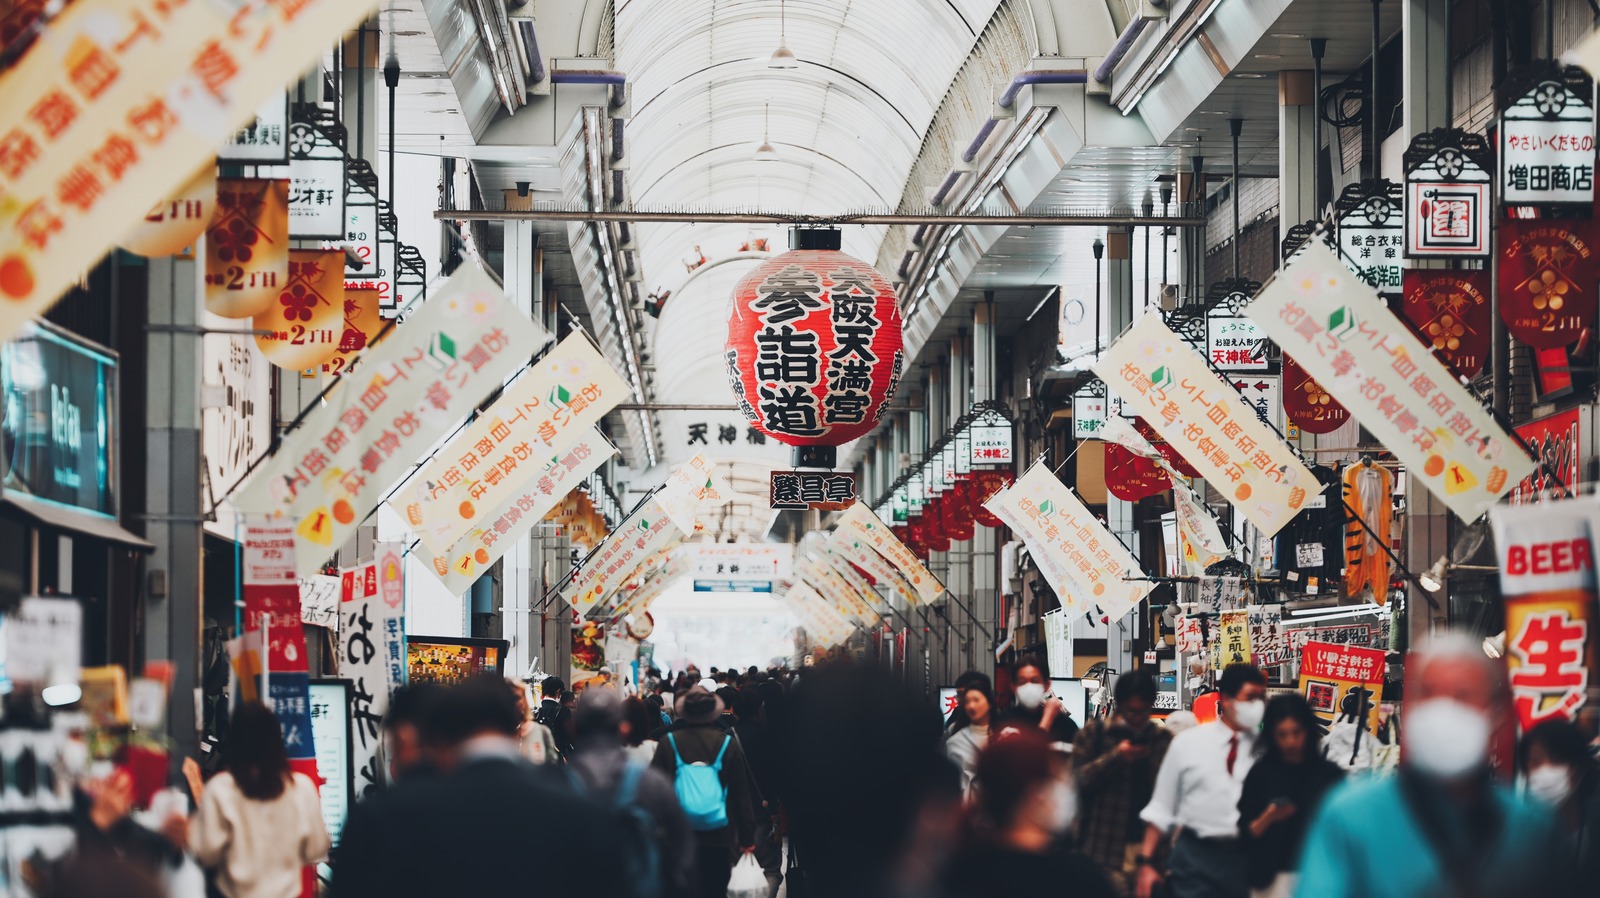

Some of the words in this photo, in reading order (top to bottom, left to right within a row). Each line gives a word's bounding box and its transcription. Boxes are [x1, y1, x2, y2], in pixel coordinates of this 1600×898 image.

[1508, 134, 1593, 151] やさい・くだもの
[1507, 164, 1593, 191] 増田商店
[1351, 235, 1402, 247] 総合衣料
[1221, 323, 1255, 333] ようこそ
[1515, 313, 1580, 331] 天神橋2丁目
[755, 264, 828, 436] 参詣道
[824, 265, 879, 424] 大阪天満宮
[1215, 338, 1261, 347] お迎え人形の
[338, 326, 510, 497] お買い物・お食事は
[1294, 407, 1343, 421] 天神橋2丁目
[432, 396, 540, 500] 2丁目商店街で
[467, 382, 602, 501] お買い物・お食事は
[974, 448, 1010, 459] 天神橋2
[480, 442, 592, 548] お買い物・お食事は
[773, 474, 855, 502] 繁昌亭
[1506, 537, 1594, 576] BEER
[1200, 580, 1212, 604] 長袖
[1225, 580, 1238, 604] 半袖
